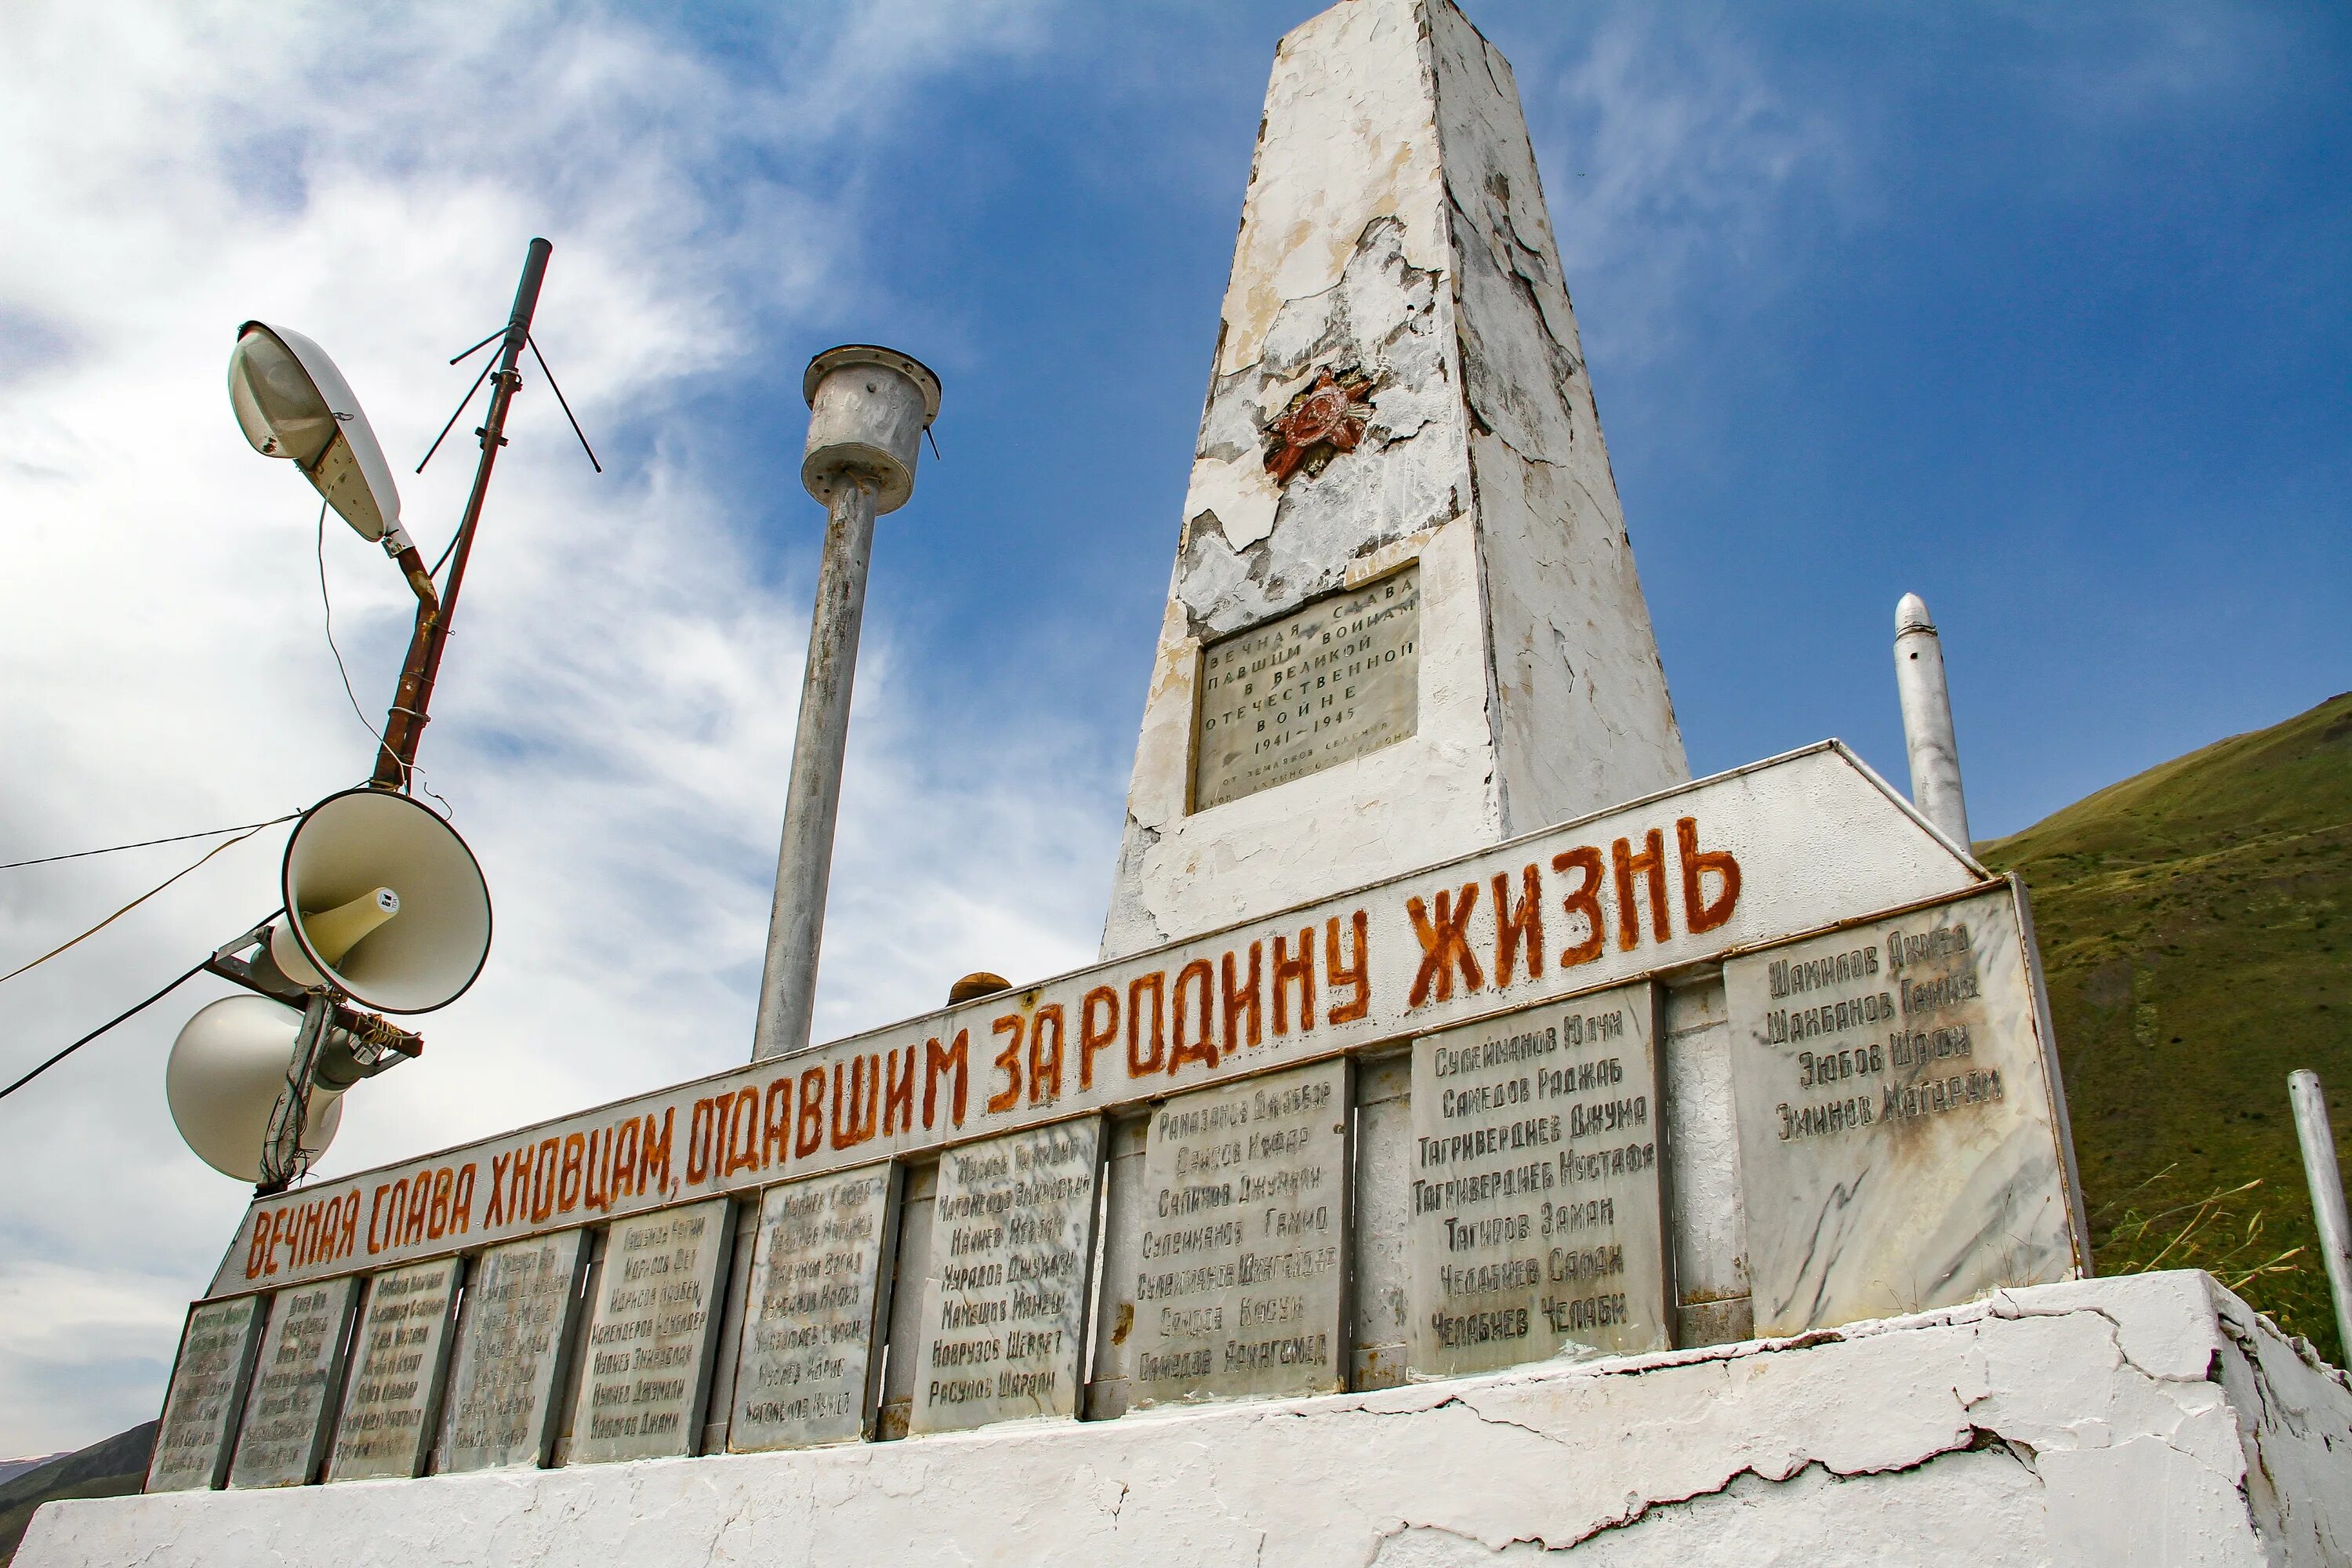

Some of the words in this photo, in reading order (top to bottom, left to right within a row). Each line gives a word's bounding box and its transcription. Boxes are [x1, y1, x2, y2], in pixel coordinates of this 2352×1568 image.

[1207, 644, 1301, 691] ПАВШИМ
[1322, 598, 1414, 644] ВОИНАМ
[1210, 623, 1301, 670] ВЕЧНАЯ
[1333, 579, 1414, 619] СЛАВА
[1205, 641, 1414, 731] ОТЕЧЕСТВЕННОЙ
[1243, 683, 1254, 697] В
[1273, 634, 1372, 686] ВЕЛИКОЙ
[1256, 684, 1356, 733] ВОЙНЕ
[1247, 748, 1314, 779] ЗЕМЛЯКОВ
[1766, 992, 1896, 1046] ШАХБАНОВ
[245, 1189, 361, 1279] ВЕЧНАЯ
[367, 1163, 477, 1254] СЛАВА
[687, 1028, 969, 1185] ОТДАВШИМ
[987, 1003, 1065, 1115] ЗА
[1079, 909, 1372, 1091] РОДИНУ
[1406, 816, 1743, 1009] ЖИЗНЬ
[1435, 1025, 1557, 1080] СУЛЕЙМАНОВ
[1443, 1077, 1530, 1119] САМЕДОВ
[1537, 1058, 1624, 1100] РАДЖАБ
[1159, 1100, 1249, 1143] РАМАЗАНОВ
[1569, 1095, 1648, 1140] ДЖУМА
[1444, 1212, 1531, 1254] ТАГИРОВ
[931, 1338, 1000, 1368] НОВРУЗОВ
[928, 1375, 993, 1408] РАСУЛОВ
